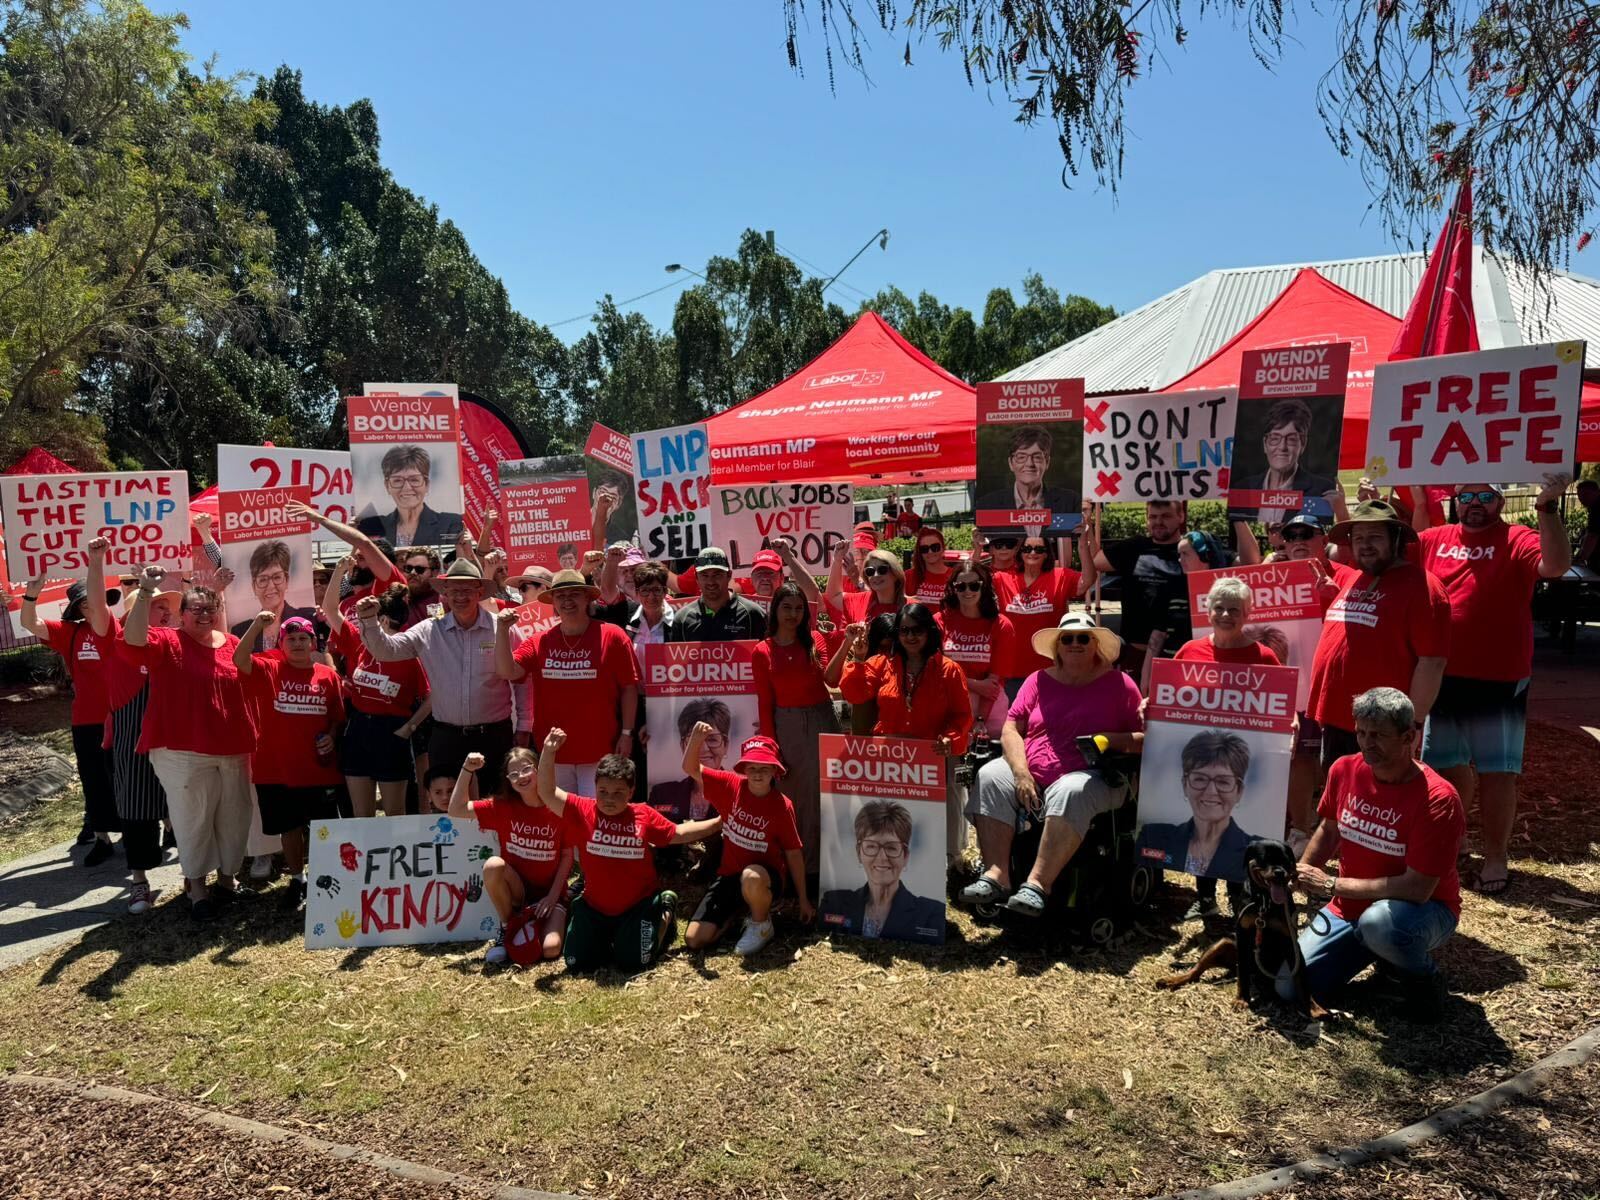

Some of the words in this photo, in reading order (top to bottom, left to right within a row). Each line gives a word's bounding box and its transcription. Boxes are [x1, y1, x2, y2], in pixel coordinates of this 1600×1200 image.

[1261, 348, 1328, 367] WENDY
[809, 373, 858, 387] Labor
[1255, 365, 1331, 383] BOURNE
[1001, 382, 1058, 397] WENDY
[1401, 365, 1558, 421] FREE
[369, 398, 432, 414] Wendy
[737, 404, 805, 419] Shayne
[808, 395, 904, 410] Neumann
[908, 390, 943, 400] MP
[997, 396, 1062, 410] BOURNE
[354, 415, 450, 431] BOURNE
[1111, 396, 1226, 440] DON'T
[786, 438, 816, 453] MP
[848, 435, 896, 445] Working
[898, 433, 914, 442] for
[917, 431, 936, 440] our
[1389, 415, 1563, 469] TAFE
[637, 428, 707, 478] LNP
[846, 447, 873, 457] local
[875, 442, 940, 456] community
[1089, 441, 1165, 470] RISK
[711, 465, 734, 475] deral
[736, 462, 775, 473] Member
[777, 462, 791, 470] for
[793, 459, 816, 469] Blair
[309, 462, 353, 498] DAY
[240, 489, 293, 508] Wendy
[506, 489, 539, 499] Wendy
[542, 486, 576, 495] Bourne
[638, 474, 711, 517] SACK
[789, 483, 850, 505] JOBS
[1261, 492, 1298, 506] Labor
[516, 498, 544, 507] Labor
[547, 496, 566, 505] will:
[17, 504, 86, 526] THE
[104, 499, 176, 525] LNP
[508, 511, 526, 522] FIX
[528, 508, 549, 520] THE
[661, 511, 695, 525] AND
[755, 506, 821, 536] VOTE
[1009, 512, 1047, 523] Labor
[234, 531, 252, 539] Labor
[264, 528, 286, 537] Ipswich
[509, 519, 569, 535] AMBERLEY
[20, 529, 83, 552] CUT
[510, 530, 591, 546] INTERCHANGE!
[514, 553, 535, 561] Labor
[1436, 543, 1495, 560] LABOR
[1281, 609, 1303, 617] West
[1333, 598, 1376, 612] Bourne
[549, 648, 591, 659] Wendy
[668, 644, 735, 662] Wendy
[944, 638, 991, 652] Bourne
[545, 658, 591, 669] Bourne
[651, 662, 754, 683] BOURNE
[1182, 663, 1266, 690] Wendy
[696, 685, 725, 693] Ipswich
[278, 691, 326, 705] Bourne
[1156, 684, 1288, 716] BOURNE
[1165, 710, 1192, 721] Labor
[1194, 712, 1207, 721] for
[1210, 714, 1246, 725] Ipswich
[1249, 719, 1273, 728] West
[844, 738, 917, 763] Wendy
[827, 758, 938, 785] BOURNE
[836, 783, 859, 792] Labor
[861, 784, 873, 792] for
[875, 786, 905, 795] Ipswich
[907, 789, 928, 797] West
[731, 801, 769, 830] Wendy
[1347, 792, 1402, 825] Wendy
[510, 820, 557, 838] Wendy
[728, 814, 766, 841] Bourne
[1341, 808, 1398, 840] Bourne
[510, 832, 554, 849] Bourne
[592, 829, 643, 846] Bourne
[365, 842, 457, 884] FREE
[361, 879, 468, 934] KINDY
